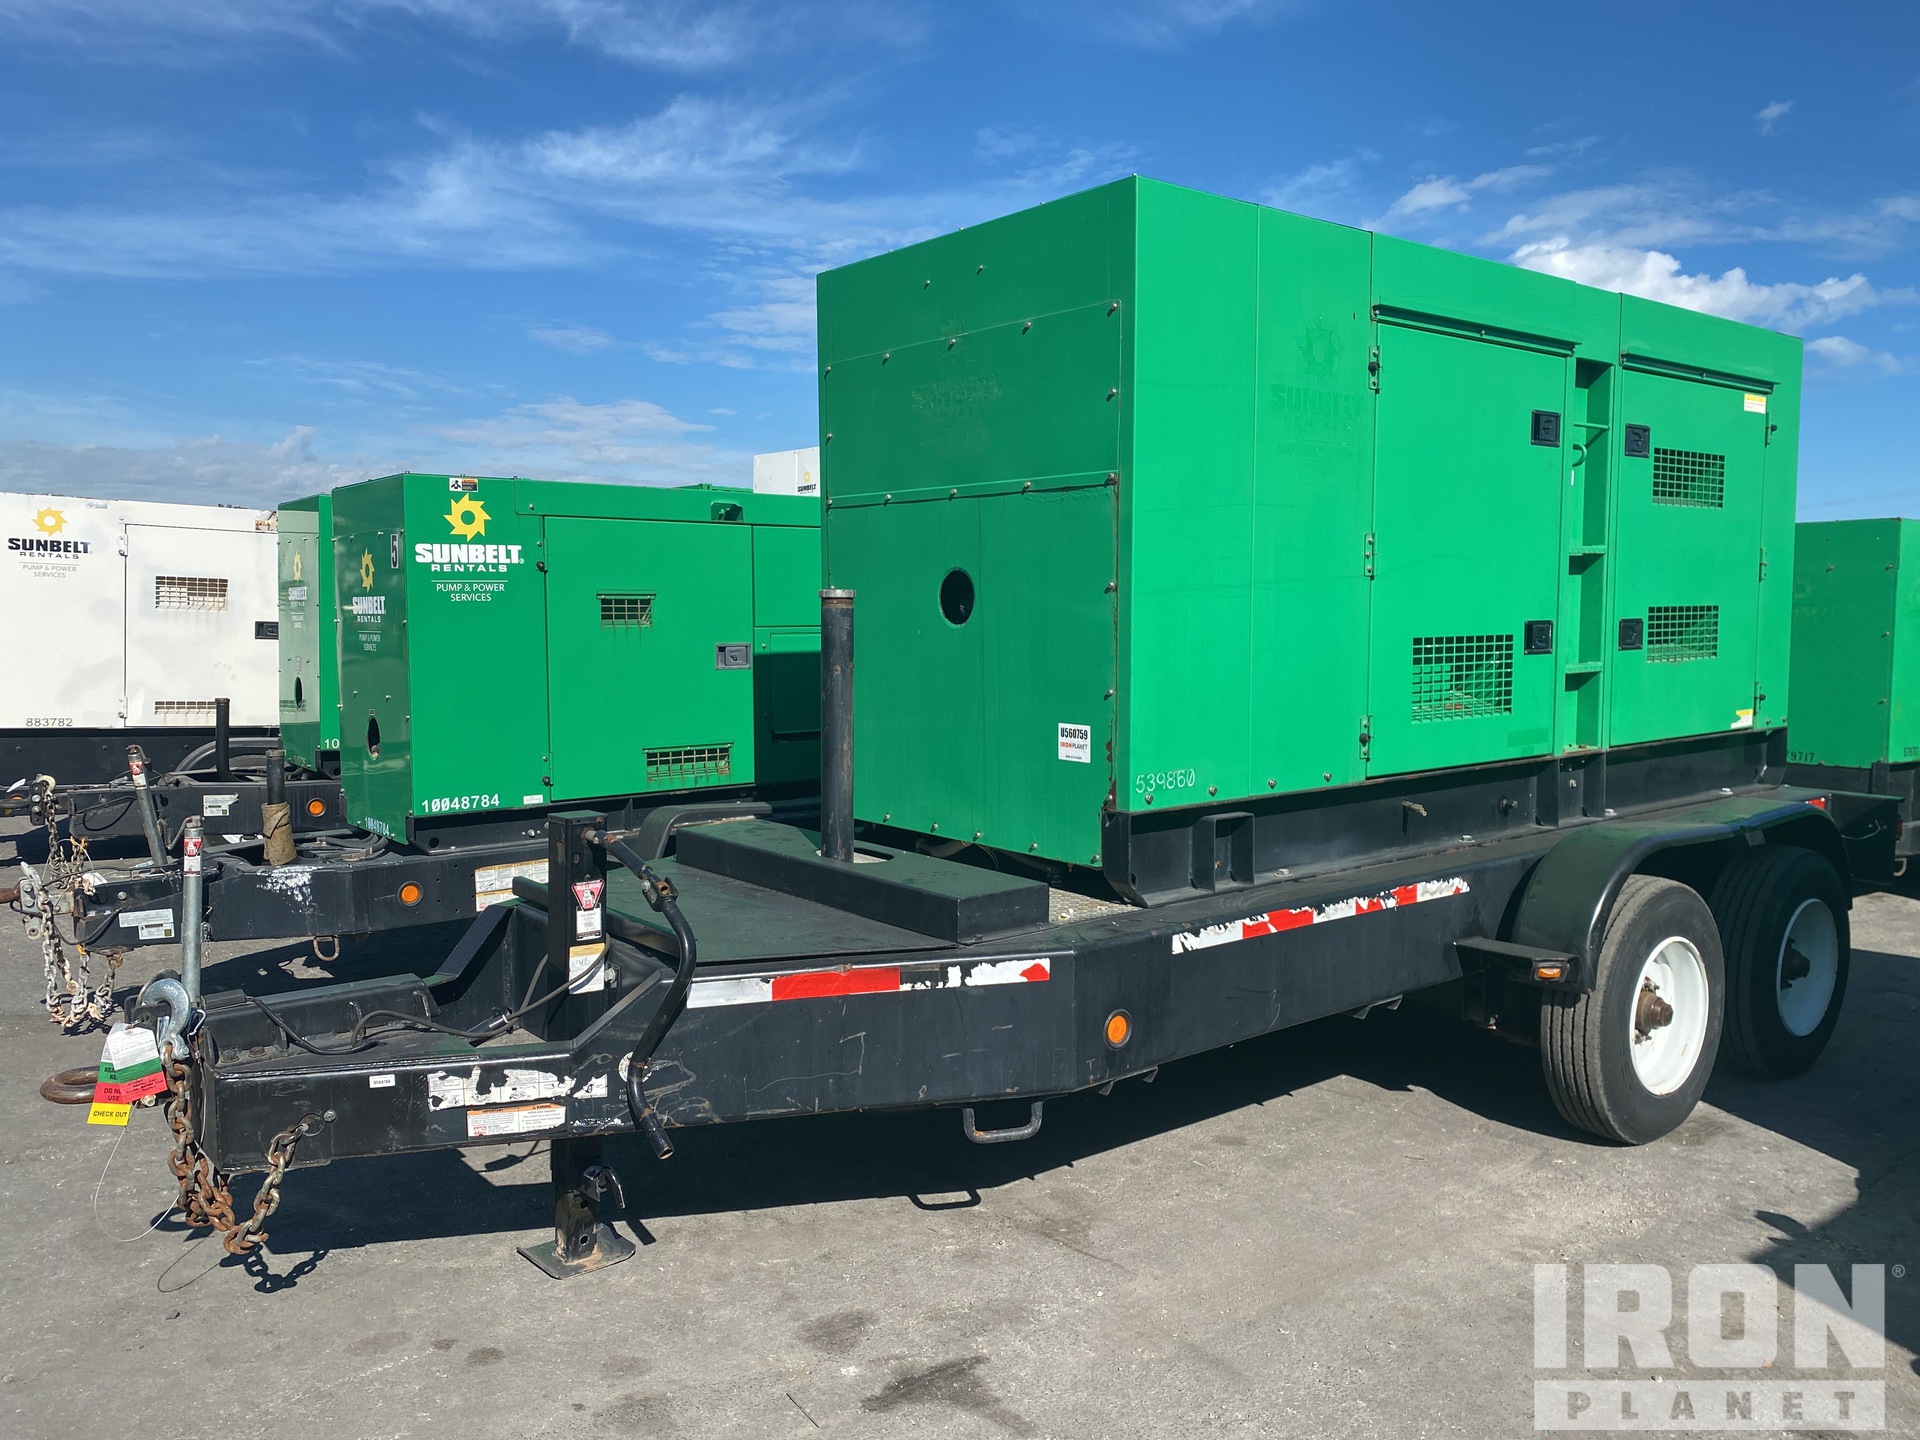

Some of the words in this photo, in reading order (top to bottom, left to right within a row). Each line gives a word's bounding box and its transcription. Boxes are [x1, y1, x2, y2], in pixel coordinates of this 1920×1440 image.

[8, 538, 91, 554] SUNBELT
[391, 534, 398, 568] 5
[20, 552, 79, 560] RENTALS
[415, 543, 522, 564] SUNBELT
[431, 564, 508, 573] RENTALS
[436, 583, 463, 592] PUMP
[463, 583, 471, 592] &
[473, 583, 505, 592] POWER
[450, 593, 492, 602] SERVICES
[352, 596, 386, 615] SUNBELT
[356, 615, 382, 623] RENTALS
[26, 717, 73, 727] 883782
[1060, 727, 1088, 740] U560759
[1136, 768, 1196, 794] 539860
[421, 793, 500, 813] 10048784
